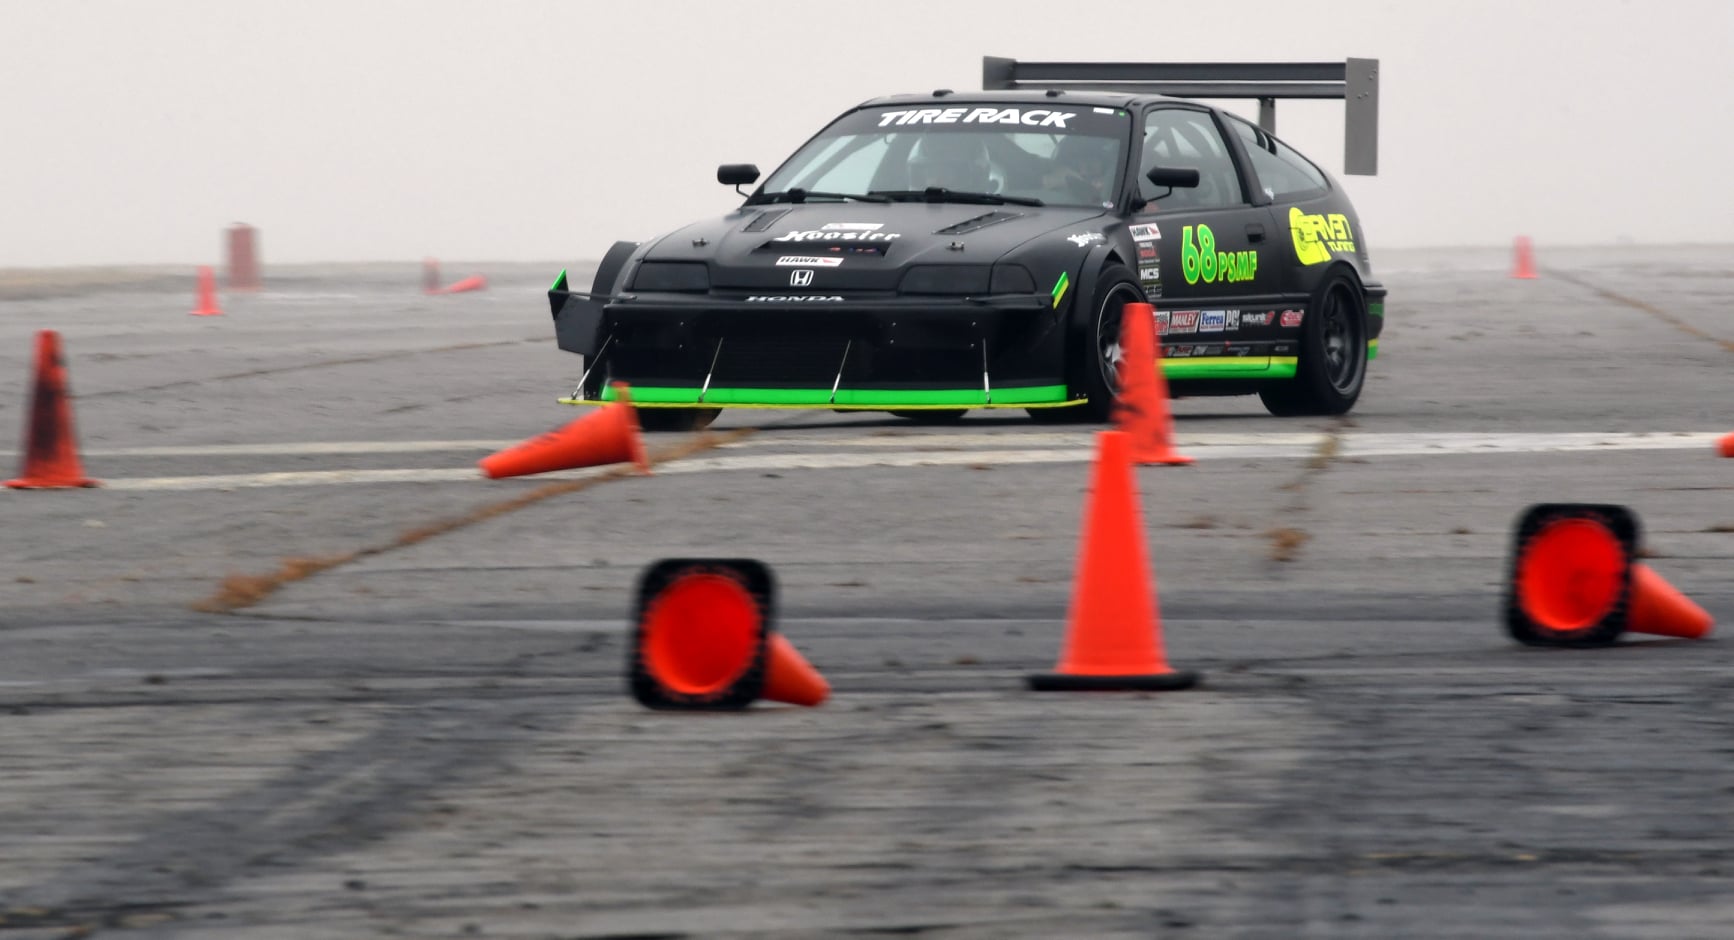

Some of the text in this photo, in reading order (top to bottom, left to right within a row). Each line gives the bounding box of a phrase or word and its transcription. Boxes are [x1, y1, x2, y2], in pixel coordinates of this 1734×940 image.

[878, 108, 1077, 128] TIRE RACK
[780, 256, 820, 264] HAWK
[1182, 224, 1257, 285] 68 PSMF
[1140, 268, 1159, 280] MCS
